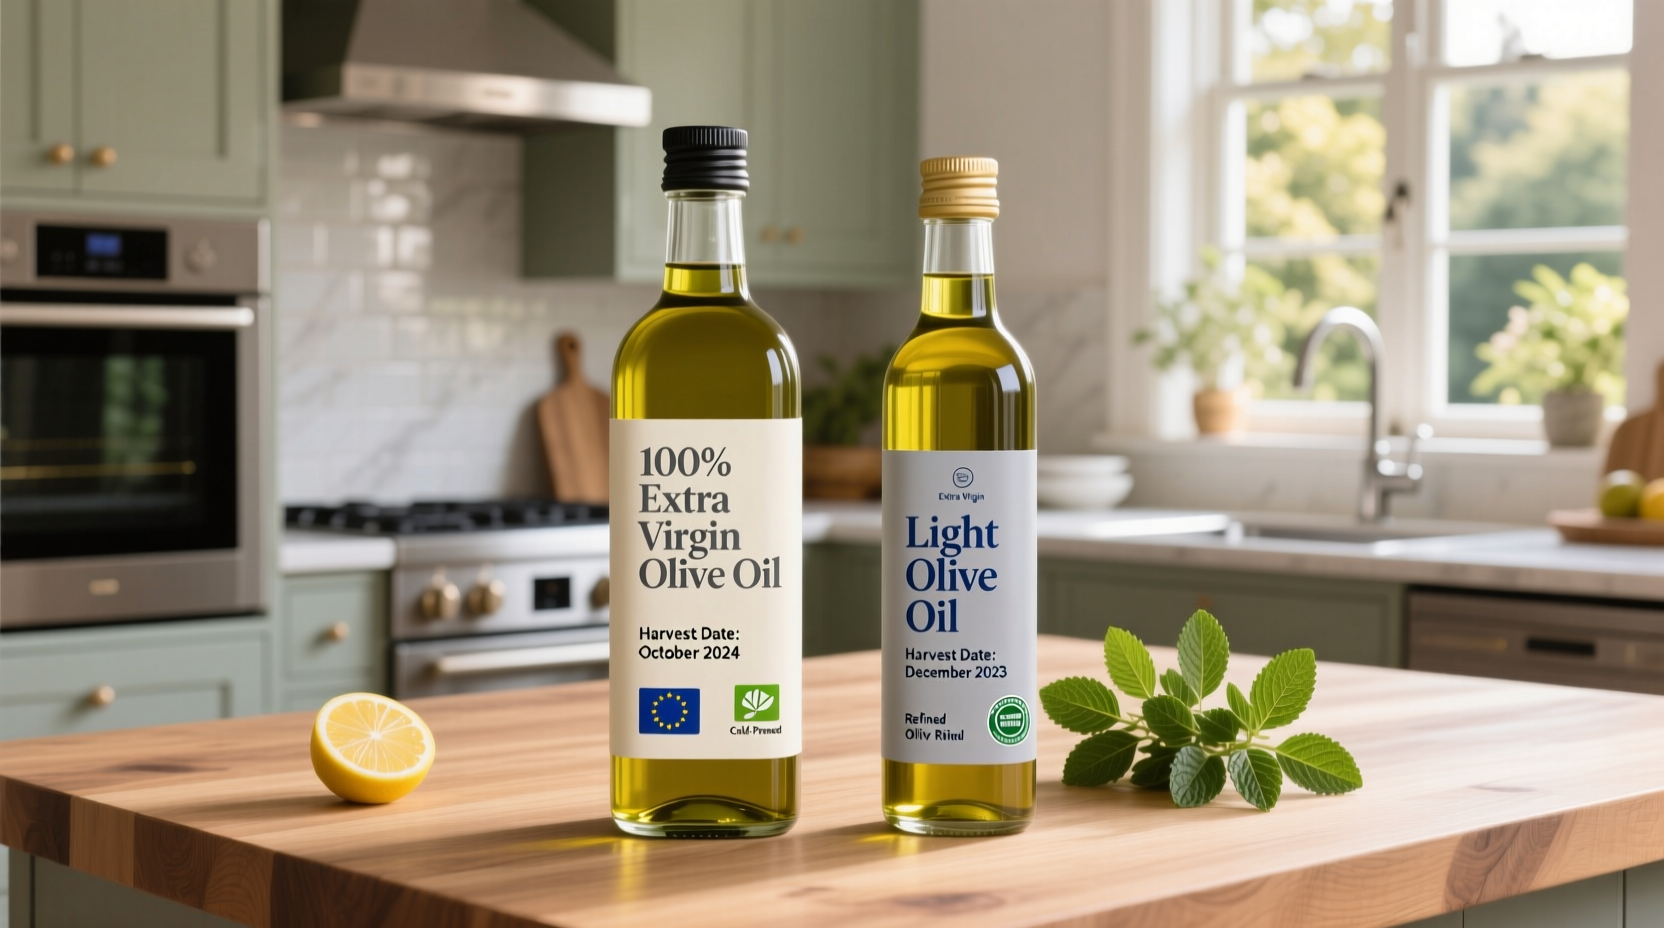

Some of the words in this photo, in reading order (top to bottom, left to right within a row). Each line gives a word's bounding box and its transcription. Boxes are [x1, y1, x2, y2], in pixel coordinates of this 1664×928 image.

[640, 446, 732, 477] 100%
[639, 484, 730, 513] Extra
[638, 520, 741, 560] Virgin
[906, 515, 999, 558] Light
[639, 558, 725, 589] Olive
[733, 556, 782, 589] Oil
[906, 558, 997, 592] Olive
[906, 599, 959, 633] Oil
[639, 627, 698, 641] Harvest
[702, 627, 739, 641] Date:
[639, 646, 699, 660] October
[703, 646, 740, 660] 2024
[905, 648, 956, 661] Harvest
[960, 648, 996, 661] Date:
[905, 666, 971, 678] December
[975, 666, 1007, 678] 2023
